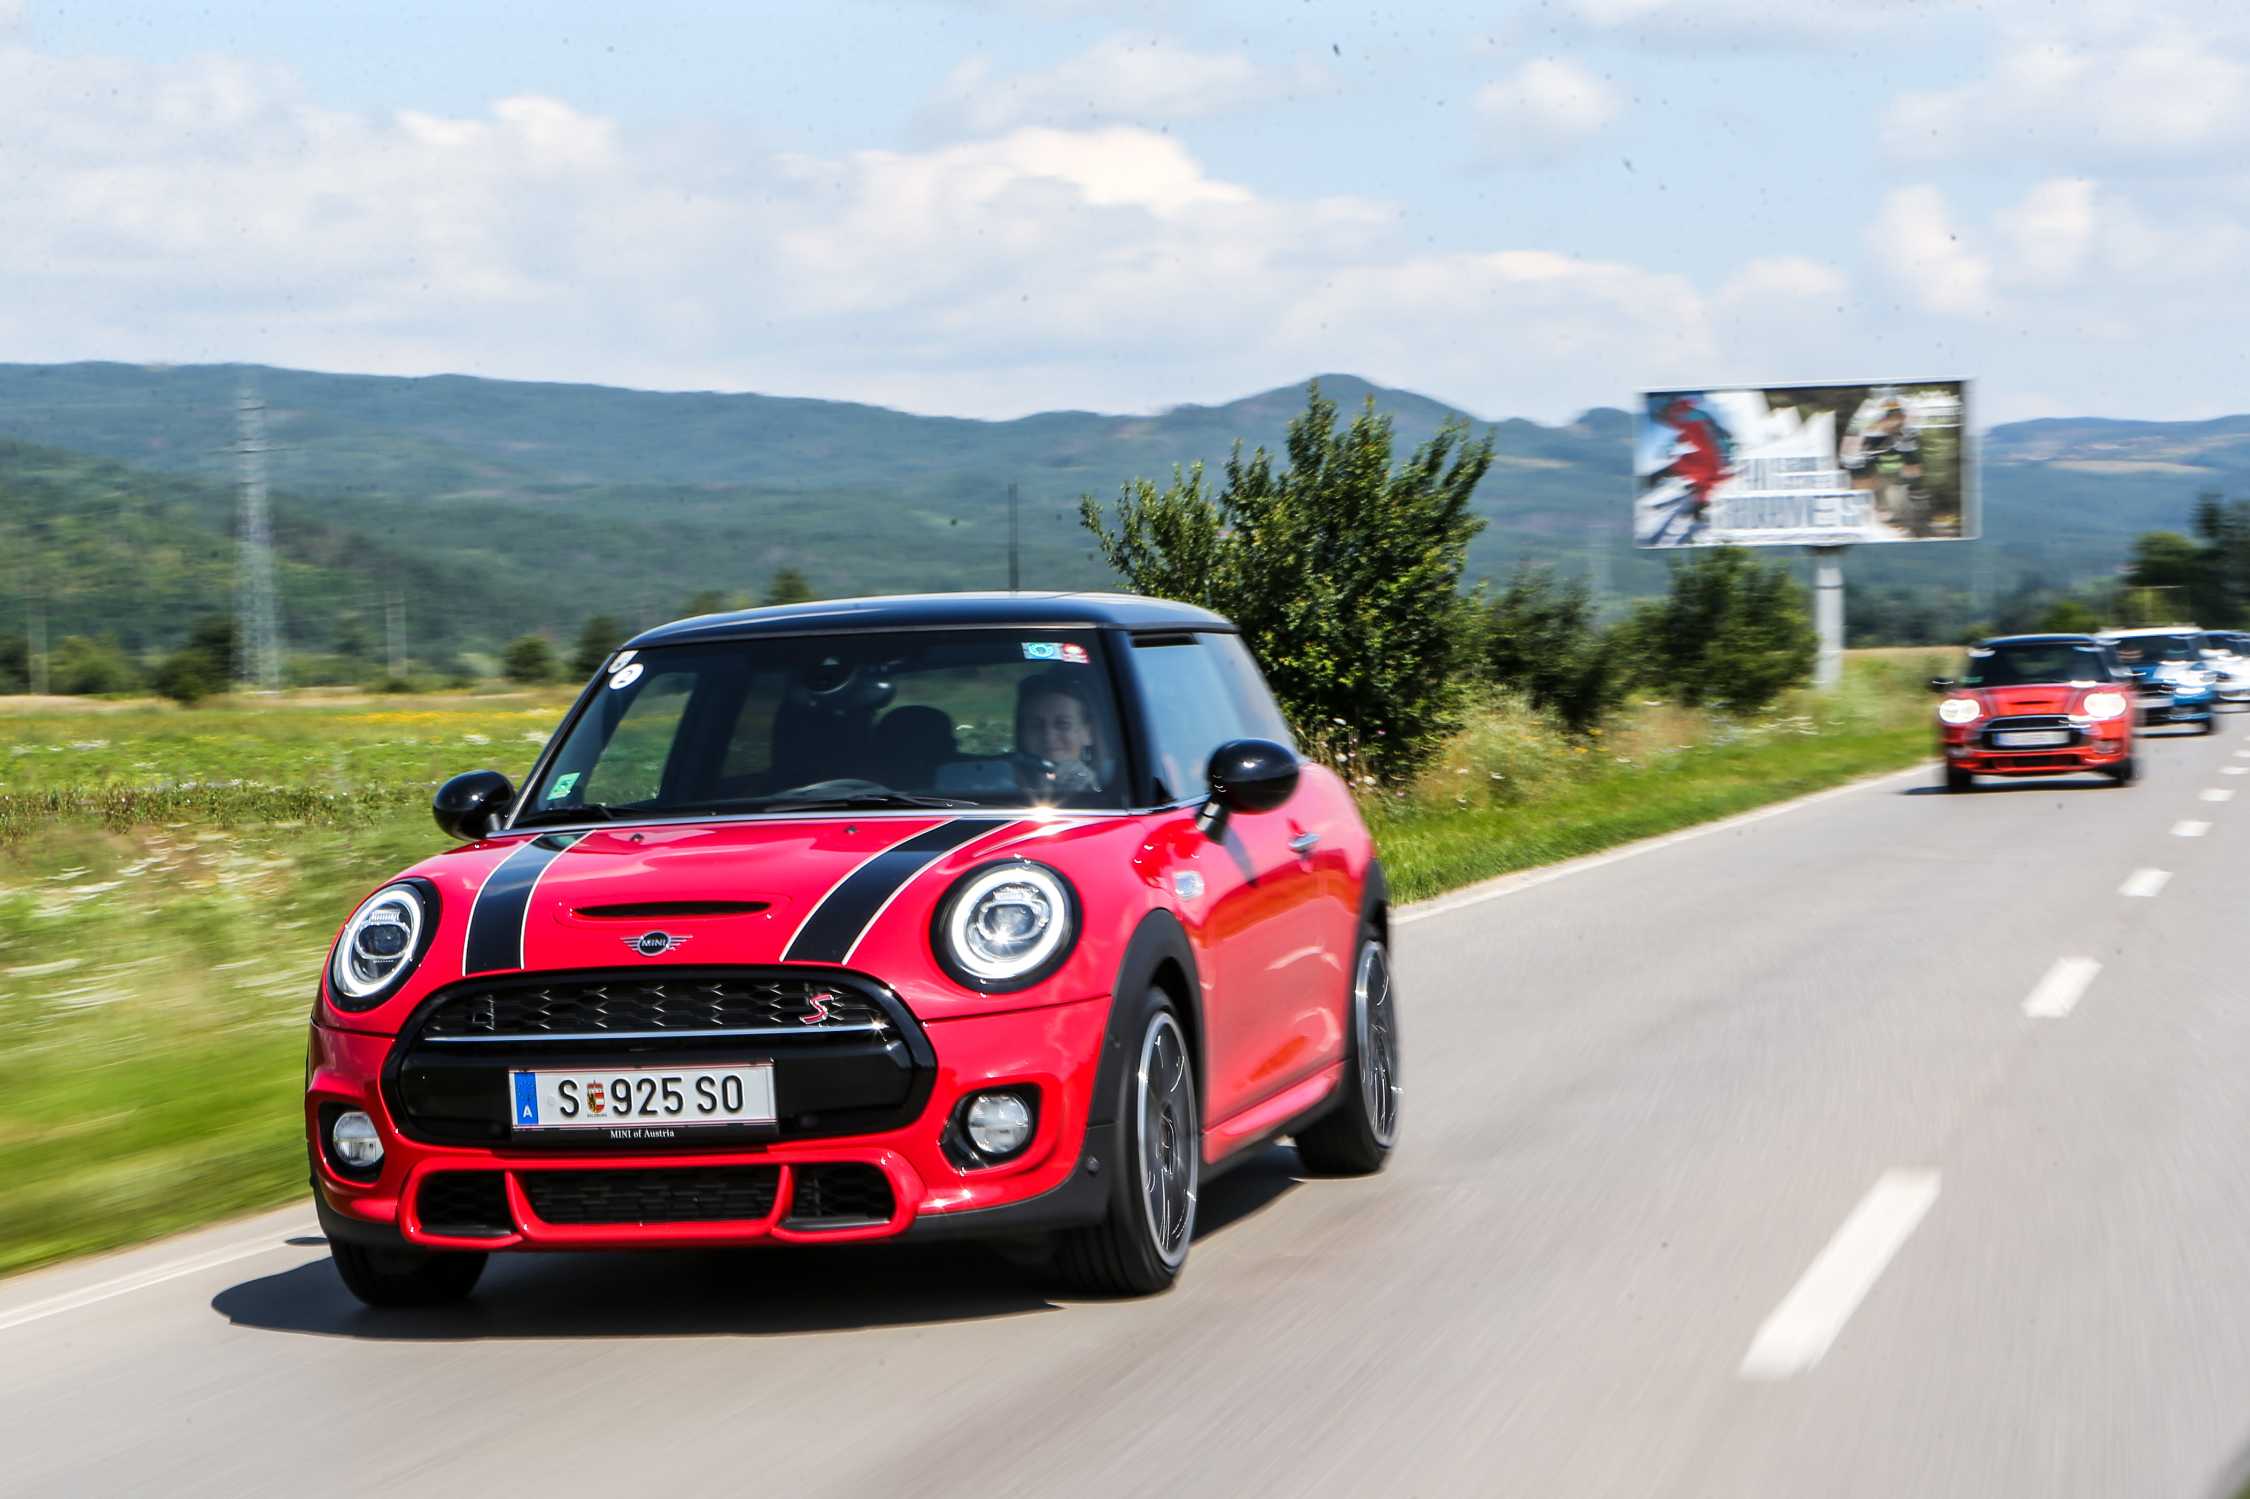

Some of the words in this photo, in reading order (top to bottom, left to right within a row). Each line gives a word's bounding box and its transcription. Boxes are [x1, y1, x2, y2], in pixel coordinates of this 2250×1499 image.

[641, 937, 666, 947] MINI
[558, 1079, 580, 1118] S
[610, 1076, 684, 1116] 925
[695, 1074, 744, 1114] SO
[523, 1104, 533, 1118] A
[610, 1130, 631, 1139] MINI
[633, 1129, 642, 1138] of
[644, 1128, 675, 1138] Austria
